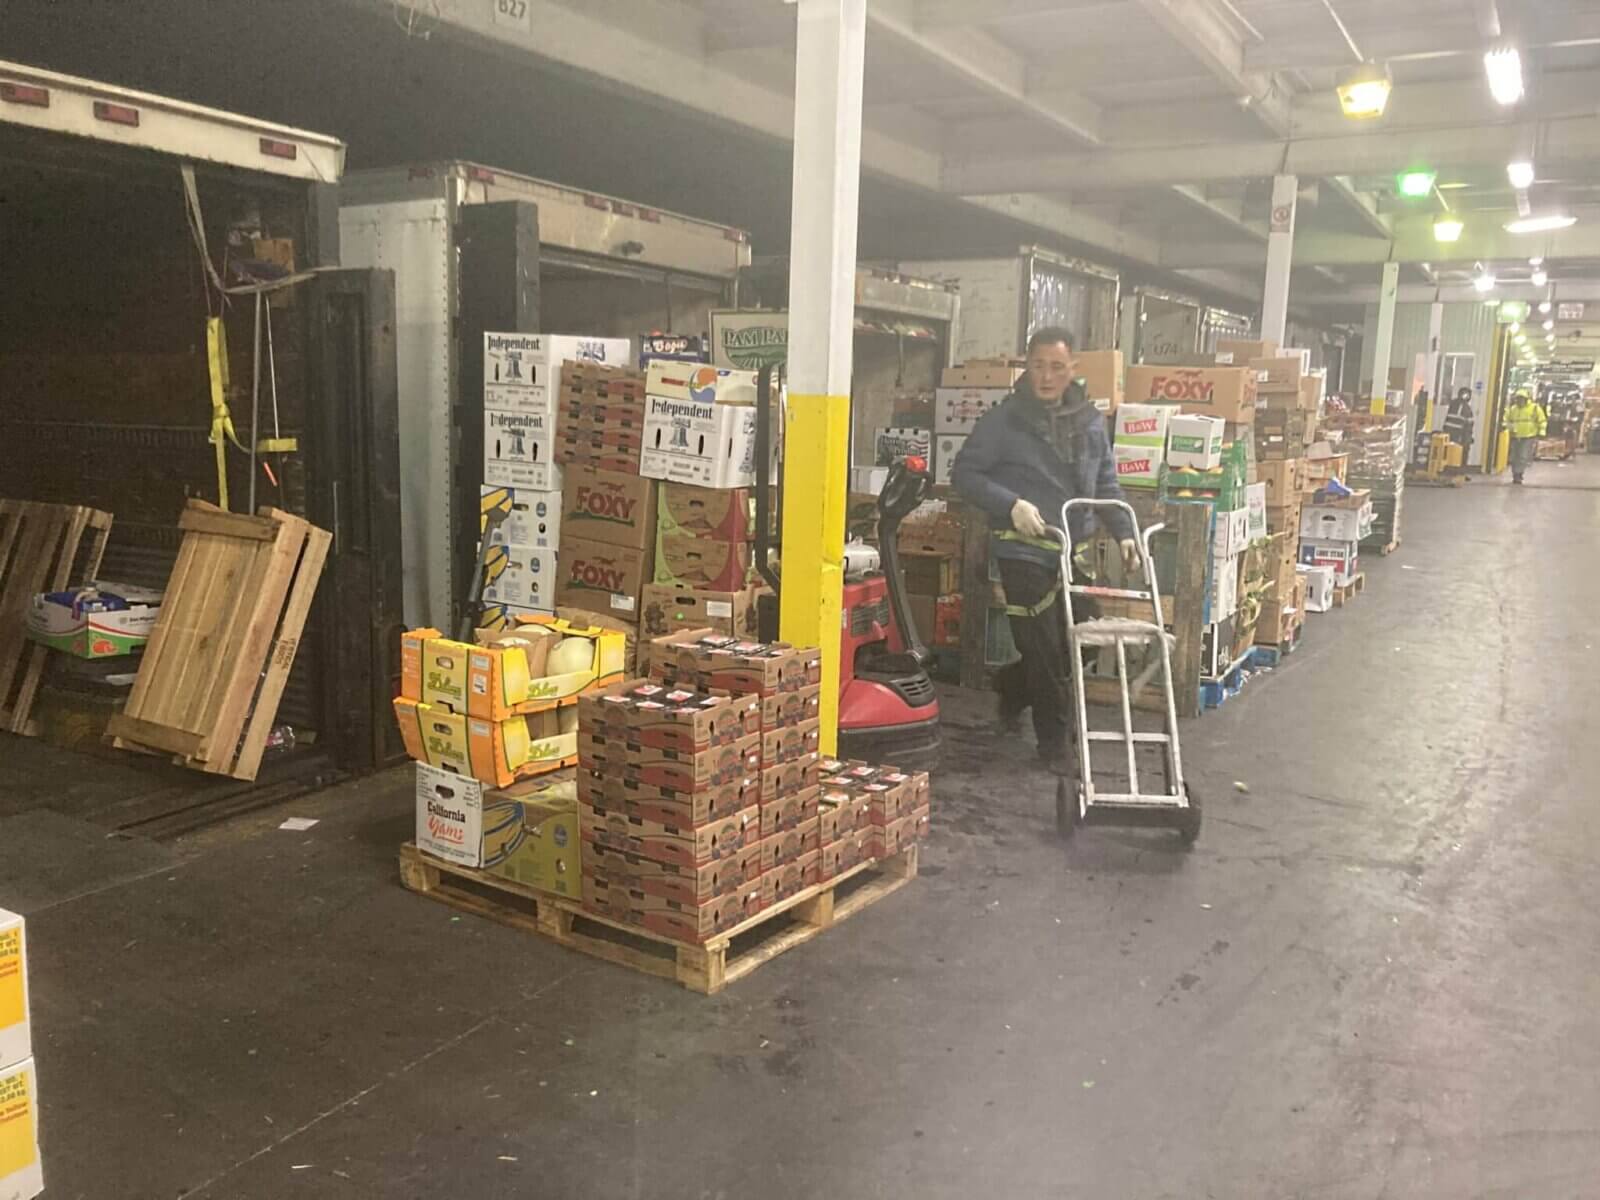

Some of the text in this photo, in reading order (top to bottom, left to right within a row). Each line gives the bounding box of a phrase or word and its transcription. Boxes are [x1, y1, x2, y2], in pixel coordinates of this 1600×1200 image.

[488, 334, 540, 352] Independent
[1151, 376, 1214, 400] FOXY
[490, 412, 543, 429] Independent
[652, 398, 713, 420] Independent
[576, 486, 638, 519] FOXY
[571, 559, 625, 590] FOXY
[427, 801, 466, 824] California
[427, 815, 465, 844] Yams
